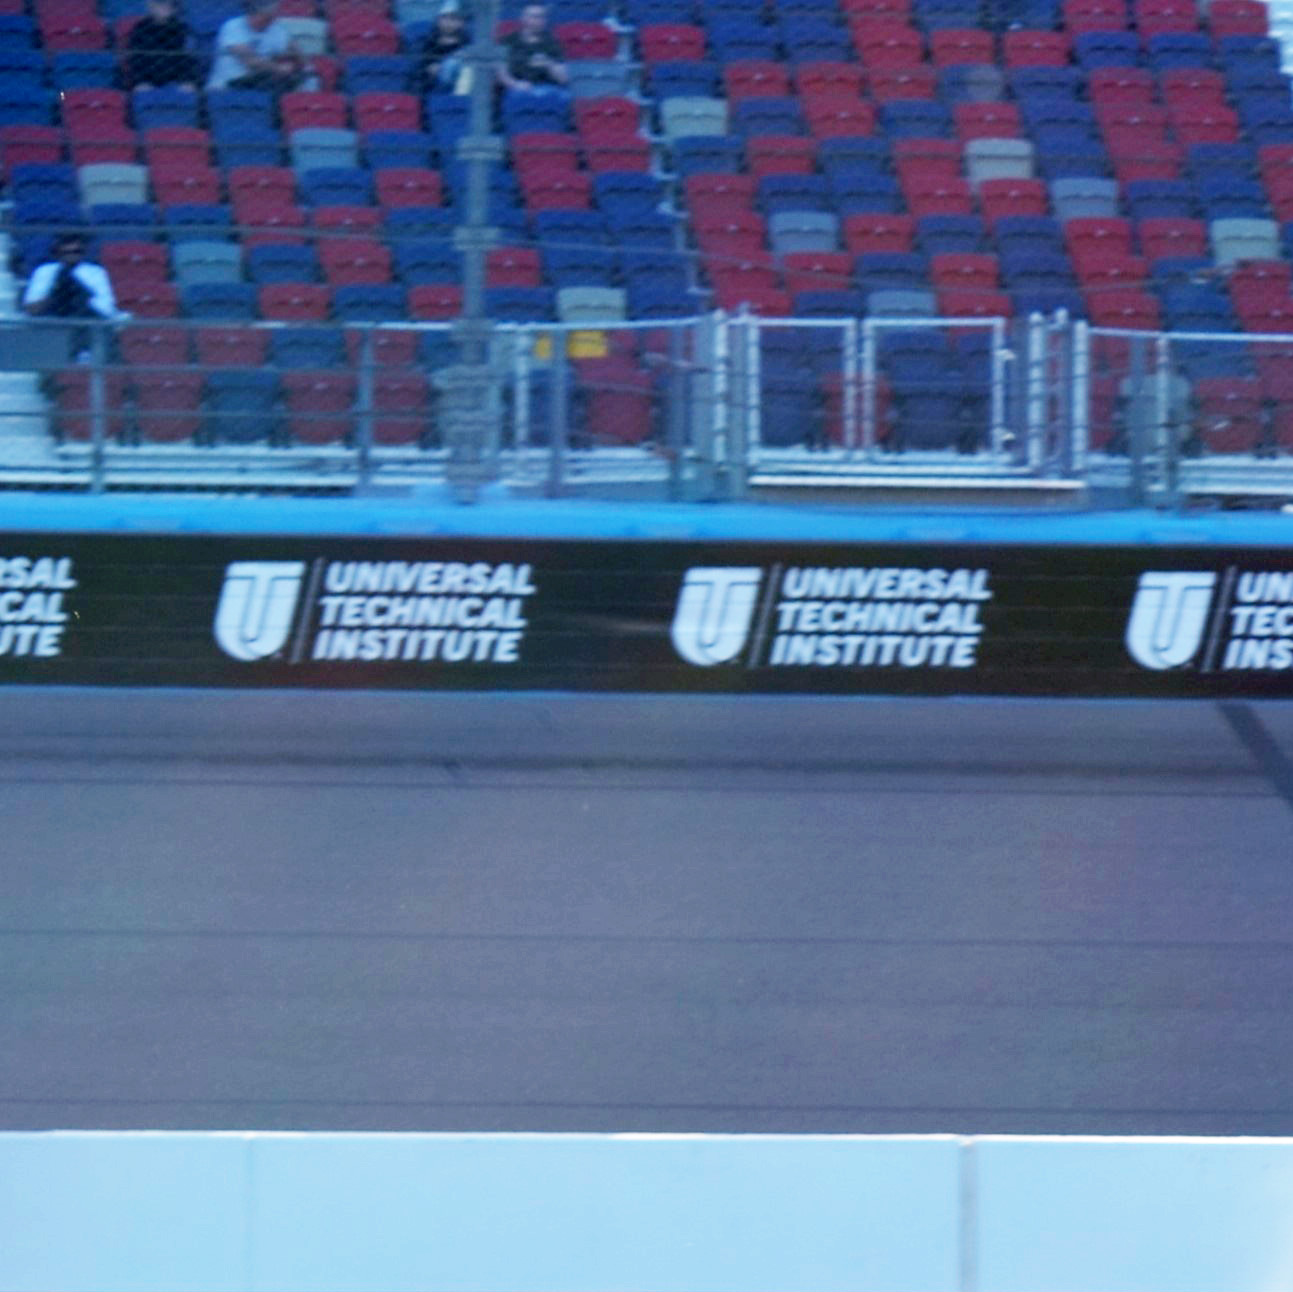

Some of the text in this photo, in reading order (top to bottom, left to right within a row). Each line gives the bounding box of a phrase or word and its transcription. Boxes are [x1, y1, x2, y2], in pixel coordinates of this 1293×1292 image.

[325, 561, 536, 595] UNIVERSAL
[782, 566, 993, 600] UNIVERSAL
[319, 597, 528, 628] TECHNICAL
[776, 602, 984, 633] TECHNICAL
[312, 629, 524, 662] INSTITUTE
[769, 634, 981, 667] INSTITUTE
